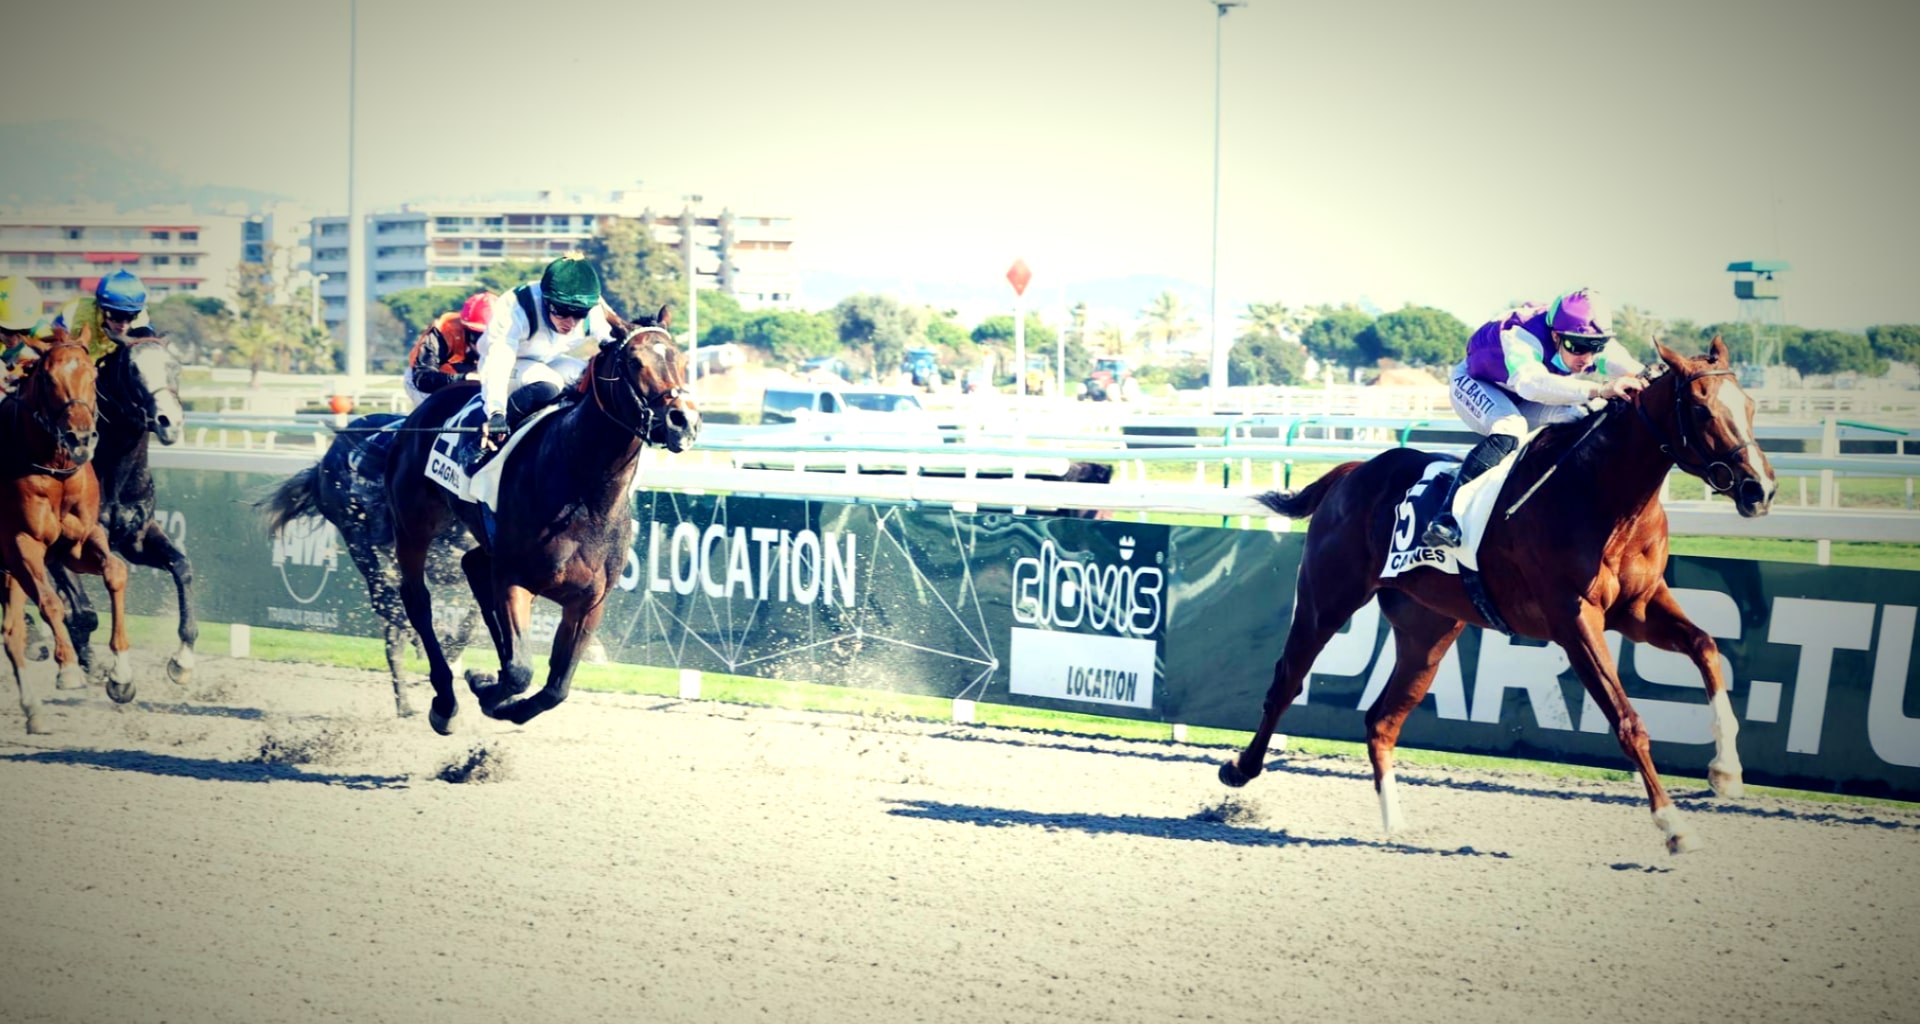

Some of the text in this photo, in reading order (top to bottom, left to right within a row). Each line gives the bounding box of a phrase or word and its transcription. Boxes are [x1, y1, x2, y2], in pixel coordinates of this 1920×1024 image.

[1454, 375, 1495, 414] ALBASTI
[650, 520, 856, 607] LOCATION
[1012, 539, 1163, 634] clovis
[1066, 665, 1138, 702] LOCATION
